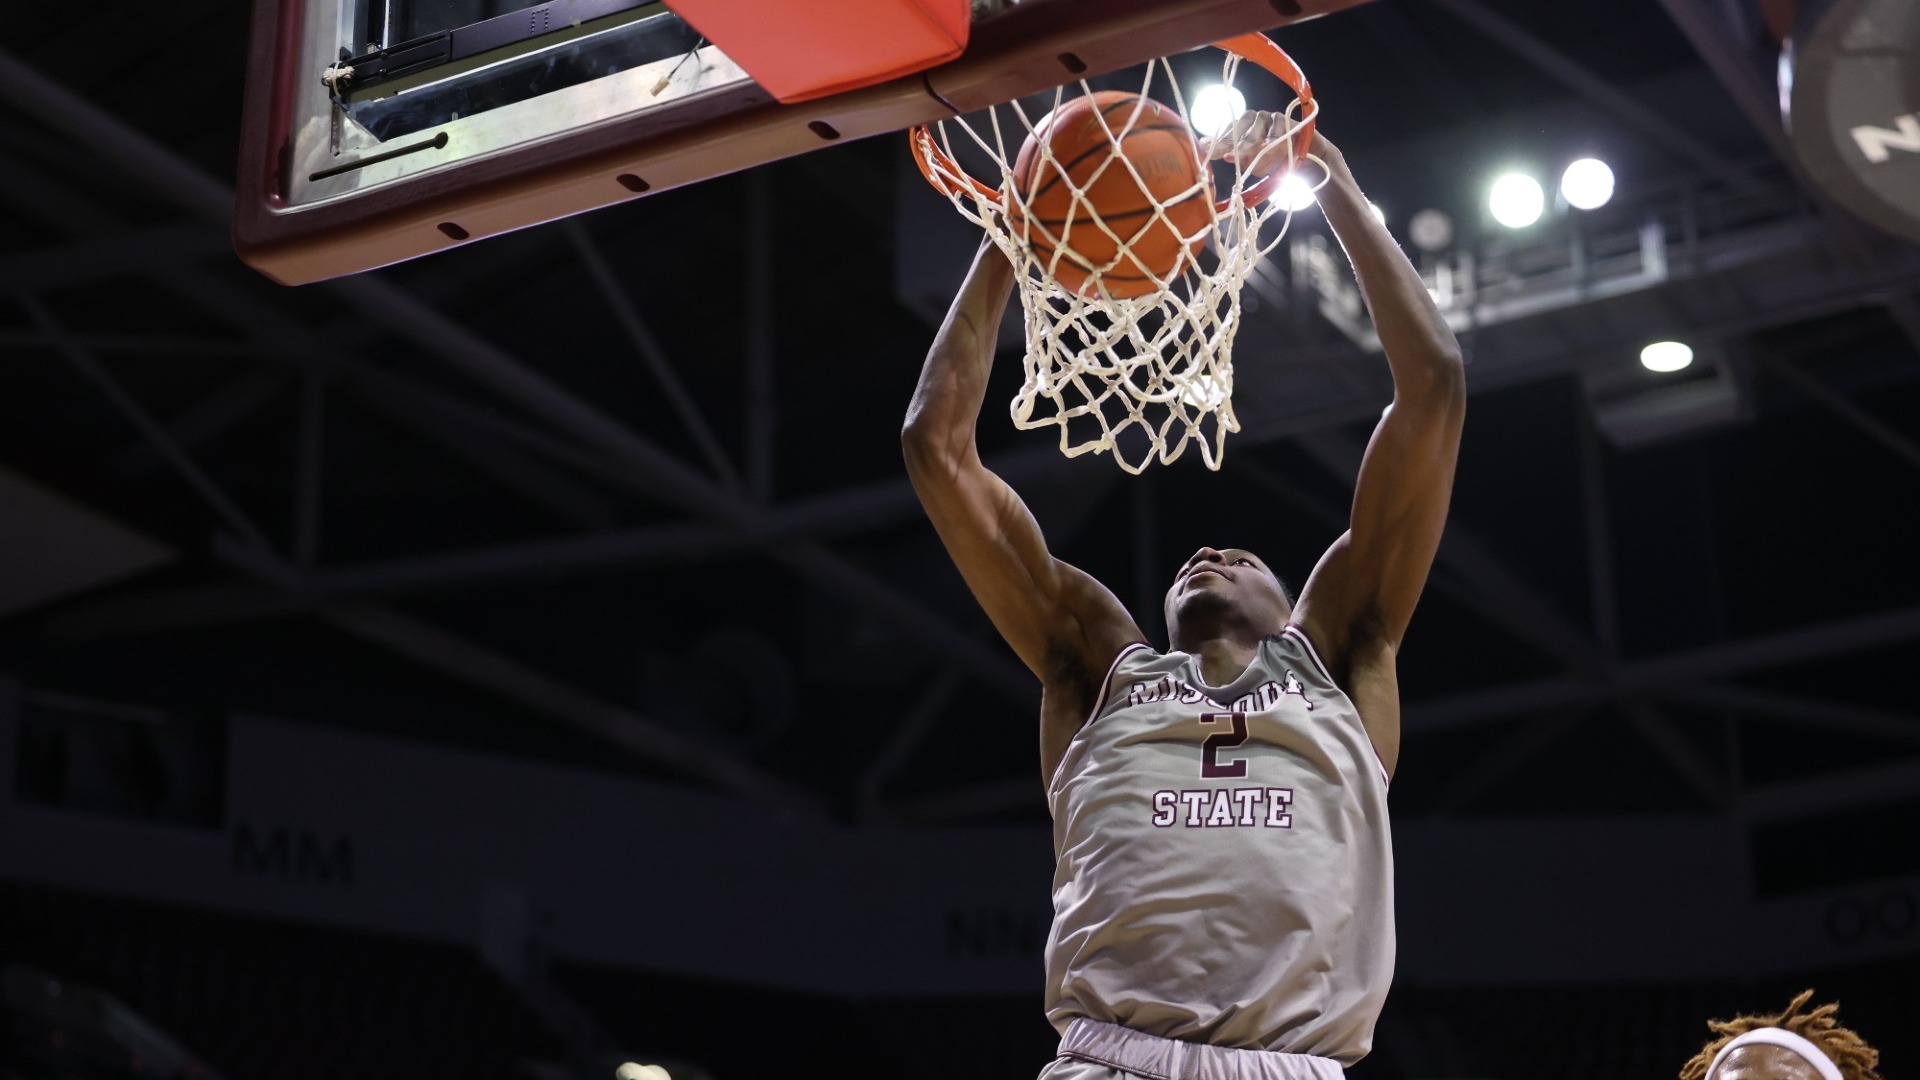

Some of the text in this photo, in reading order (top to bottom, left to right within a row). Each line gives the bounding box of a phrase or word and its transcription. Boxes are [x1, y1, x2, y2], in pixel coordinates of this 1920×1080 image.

[1199, 712, 1249, 779] 2
[1152, 787, 1294, 828] STATE
[233, 823, 353, 881] MM
